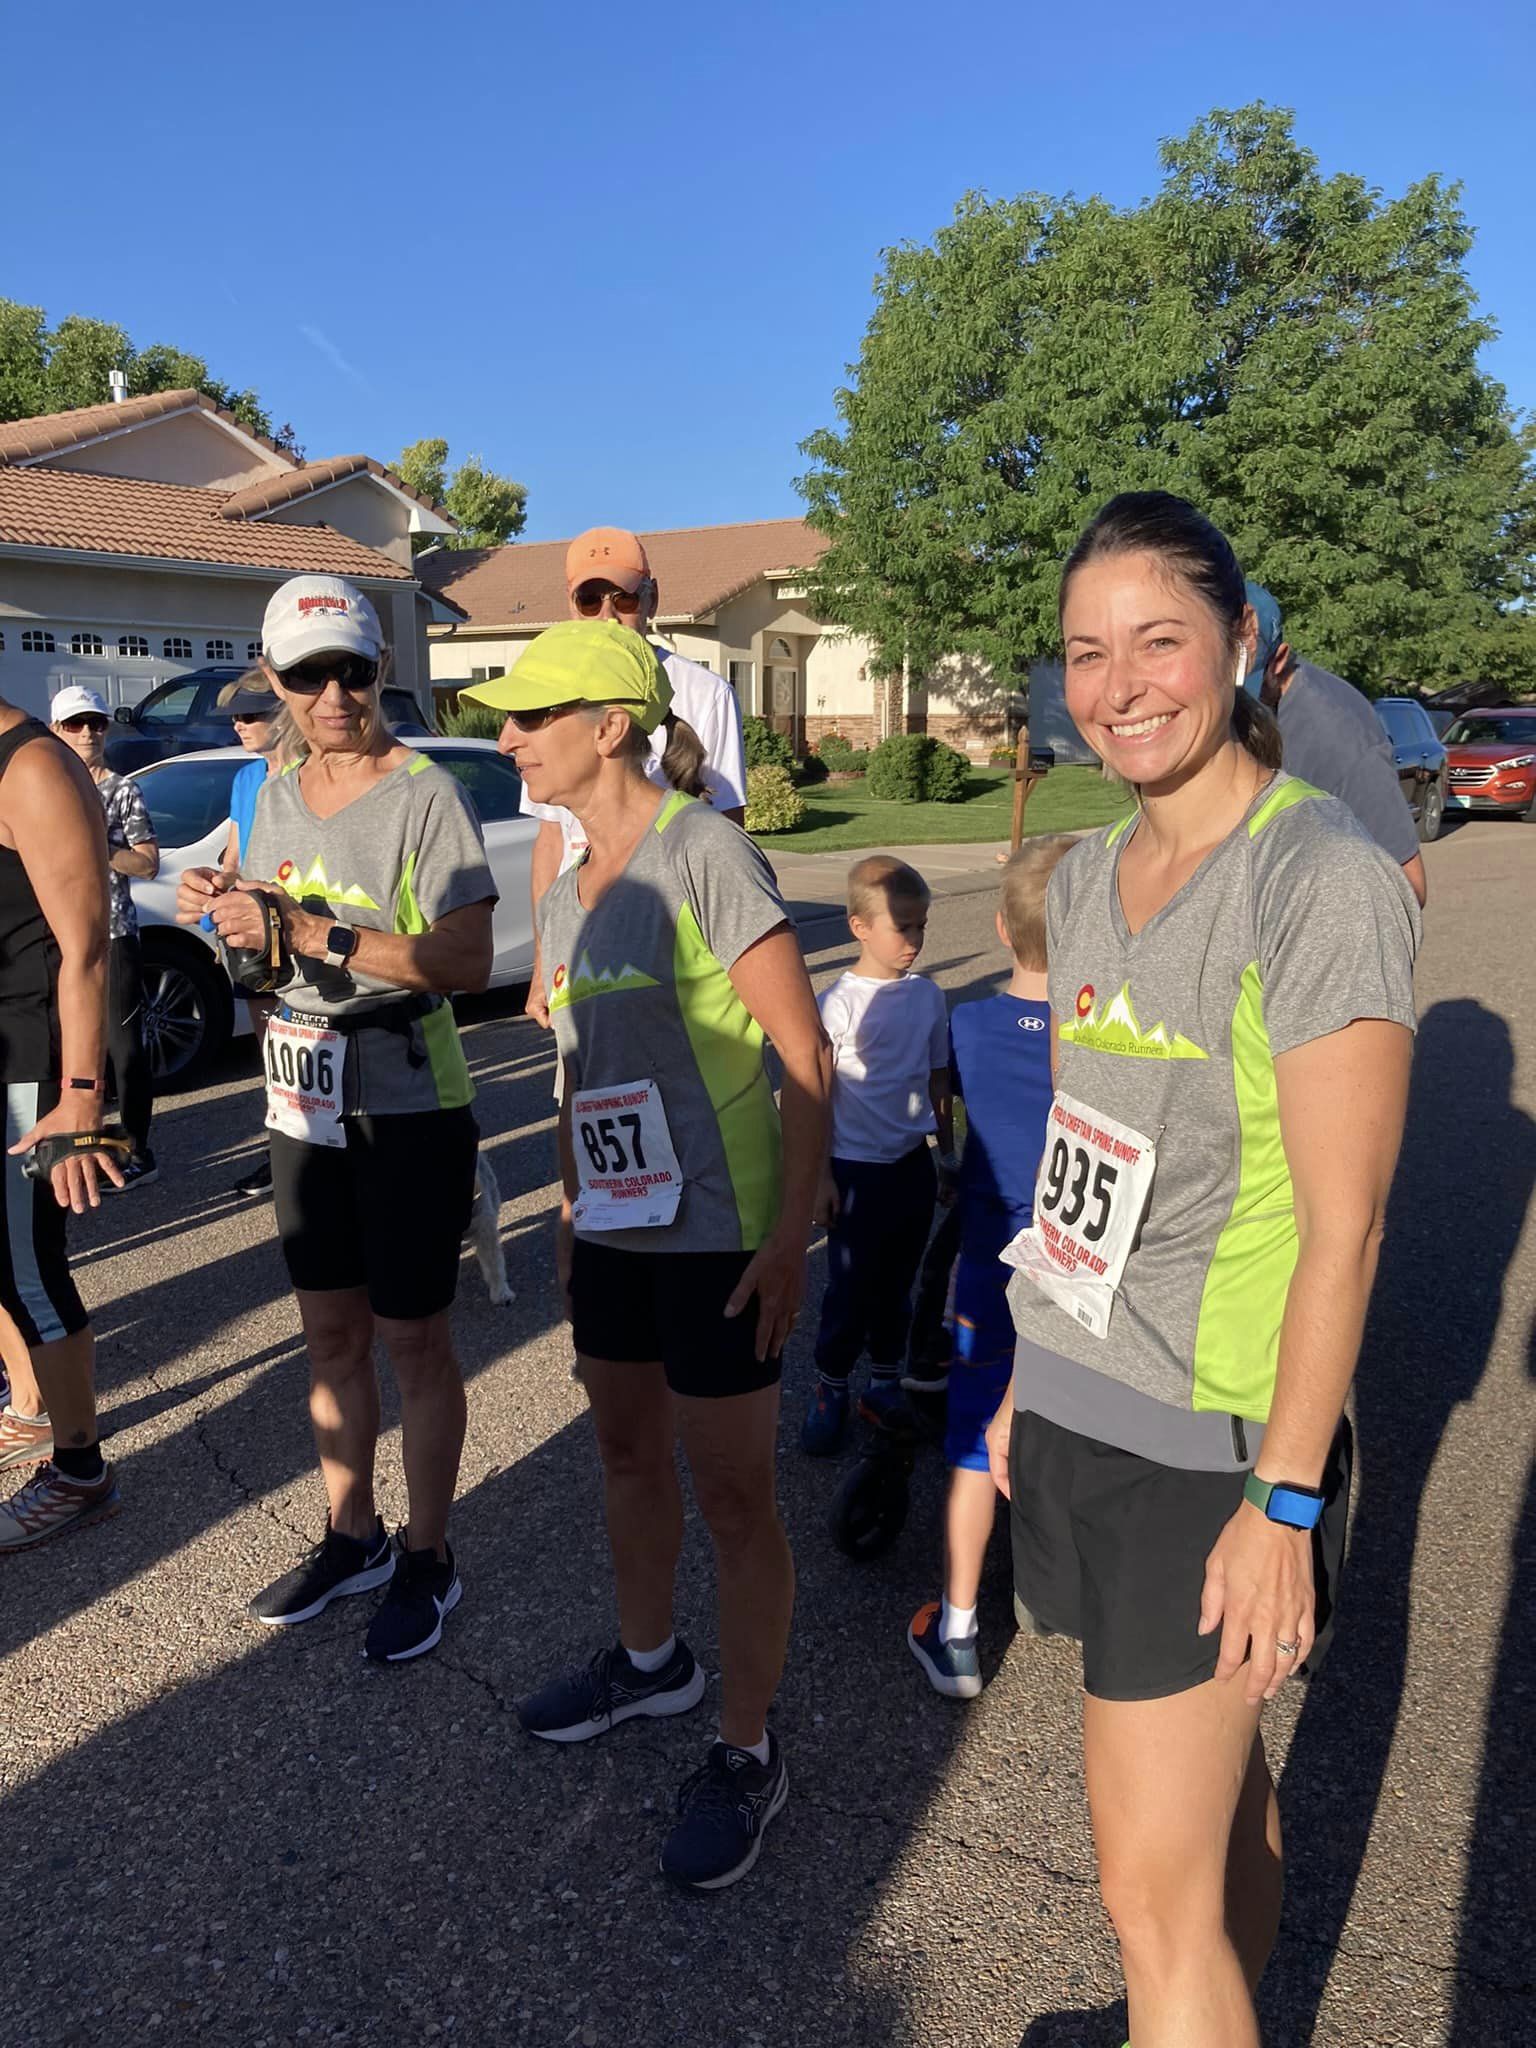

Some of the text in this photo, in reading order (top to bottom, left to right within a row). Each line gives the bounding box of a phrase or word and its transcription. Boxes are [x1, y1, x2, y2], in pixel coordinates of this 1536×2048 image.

[268, 1038, 333, 1095] 1006
[1095, 1037, 1127, 1052] Colorado
[1128, 1041, 1163, 1055] Runners
[581, 1113, 647, 1173] 857
[1065, 1112, 1093, 1141] CHIEFTAIN
[1091, 1127, 1114, 1153] SPRING
[1112, 1139, 1141, 1166] RUNOFF
[611, 1187, 648, 1199] RUNNERS
[624, 1171, 673, 1187] COLORADO
[1042, 1138, 1119, 1242] 935
[1061, 1234, 1109, 1276] COLORADO
